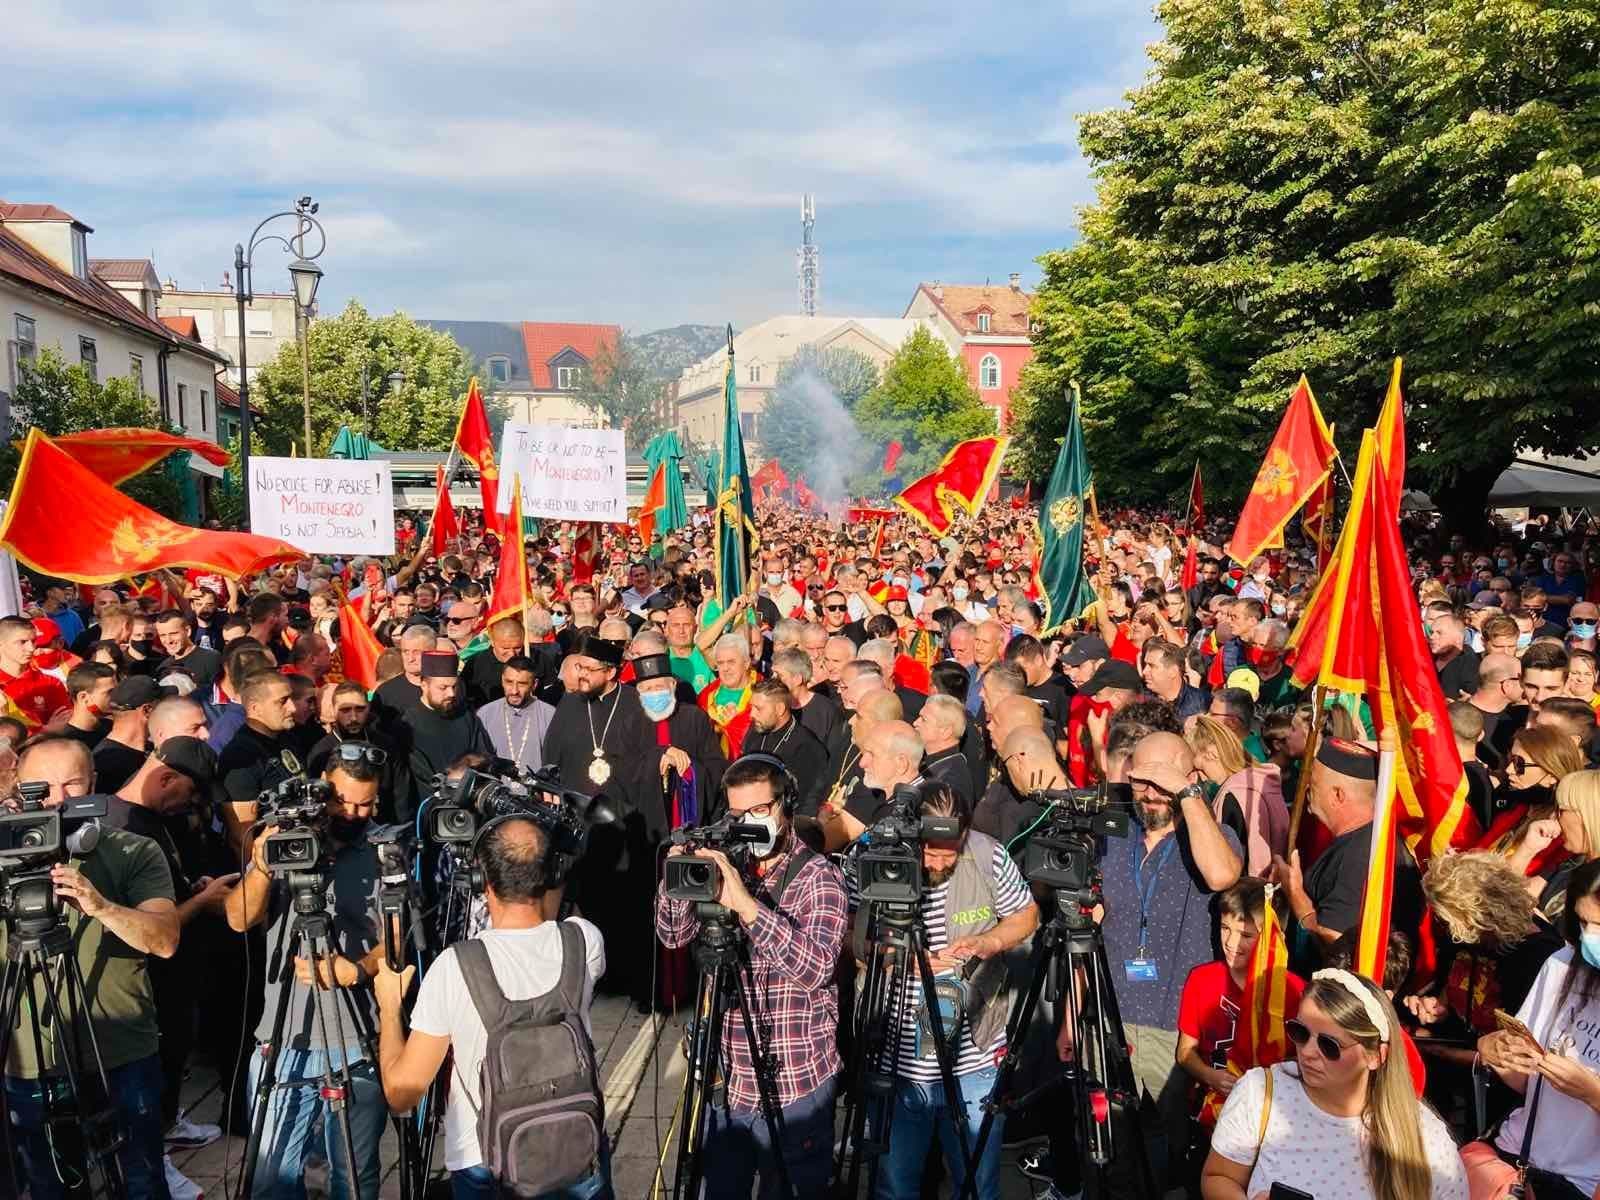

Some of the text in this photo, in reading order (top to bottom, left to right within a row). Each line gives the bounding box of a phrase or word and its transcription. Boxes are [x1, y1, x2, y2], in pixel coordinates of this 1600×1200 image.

[314, 477, 334, 493] FOR
[280, 523, 291, 537] IS
[297, 523, 318, 537] NOT
[952, 906, 992, 925] PRESS
